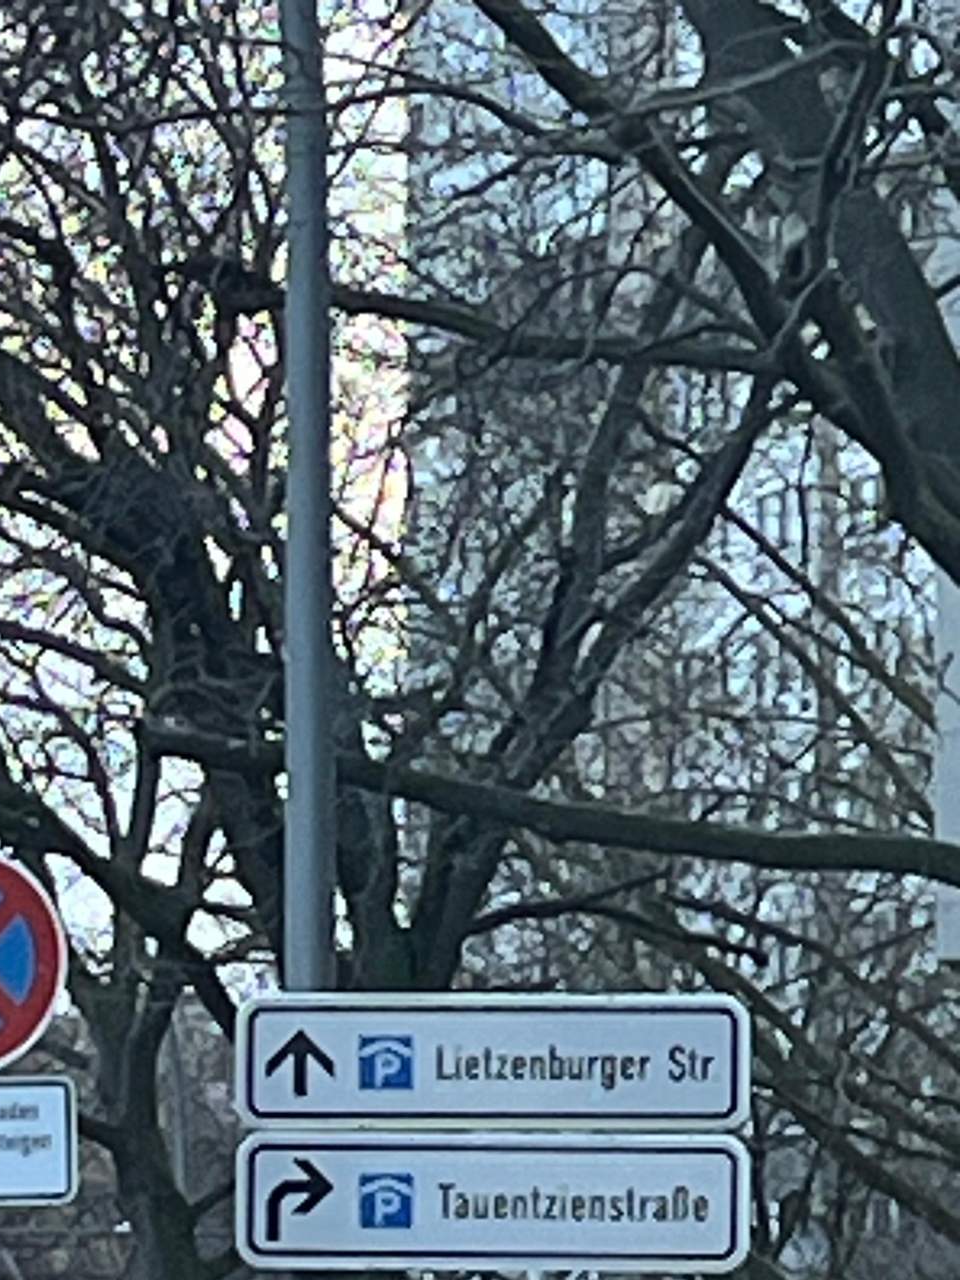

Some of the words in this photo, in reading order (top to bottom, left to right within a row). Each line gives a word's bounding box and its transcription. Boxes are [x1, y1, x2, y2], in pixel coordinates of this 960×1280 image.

[436, 1045, 650, 1090] Lietzenburger
[667, 1045, 716, 1082] Str
[438, 1182, 710, 1223] Tauentzienstraße
